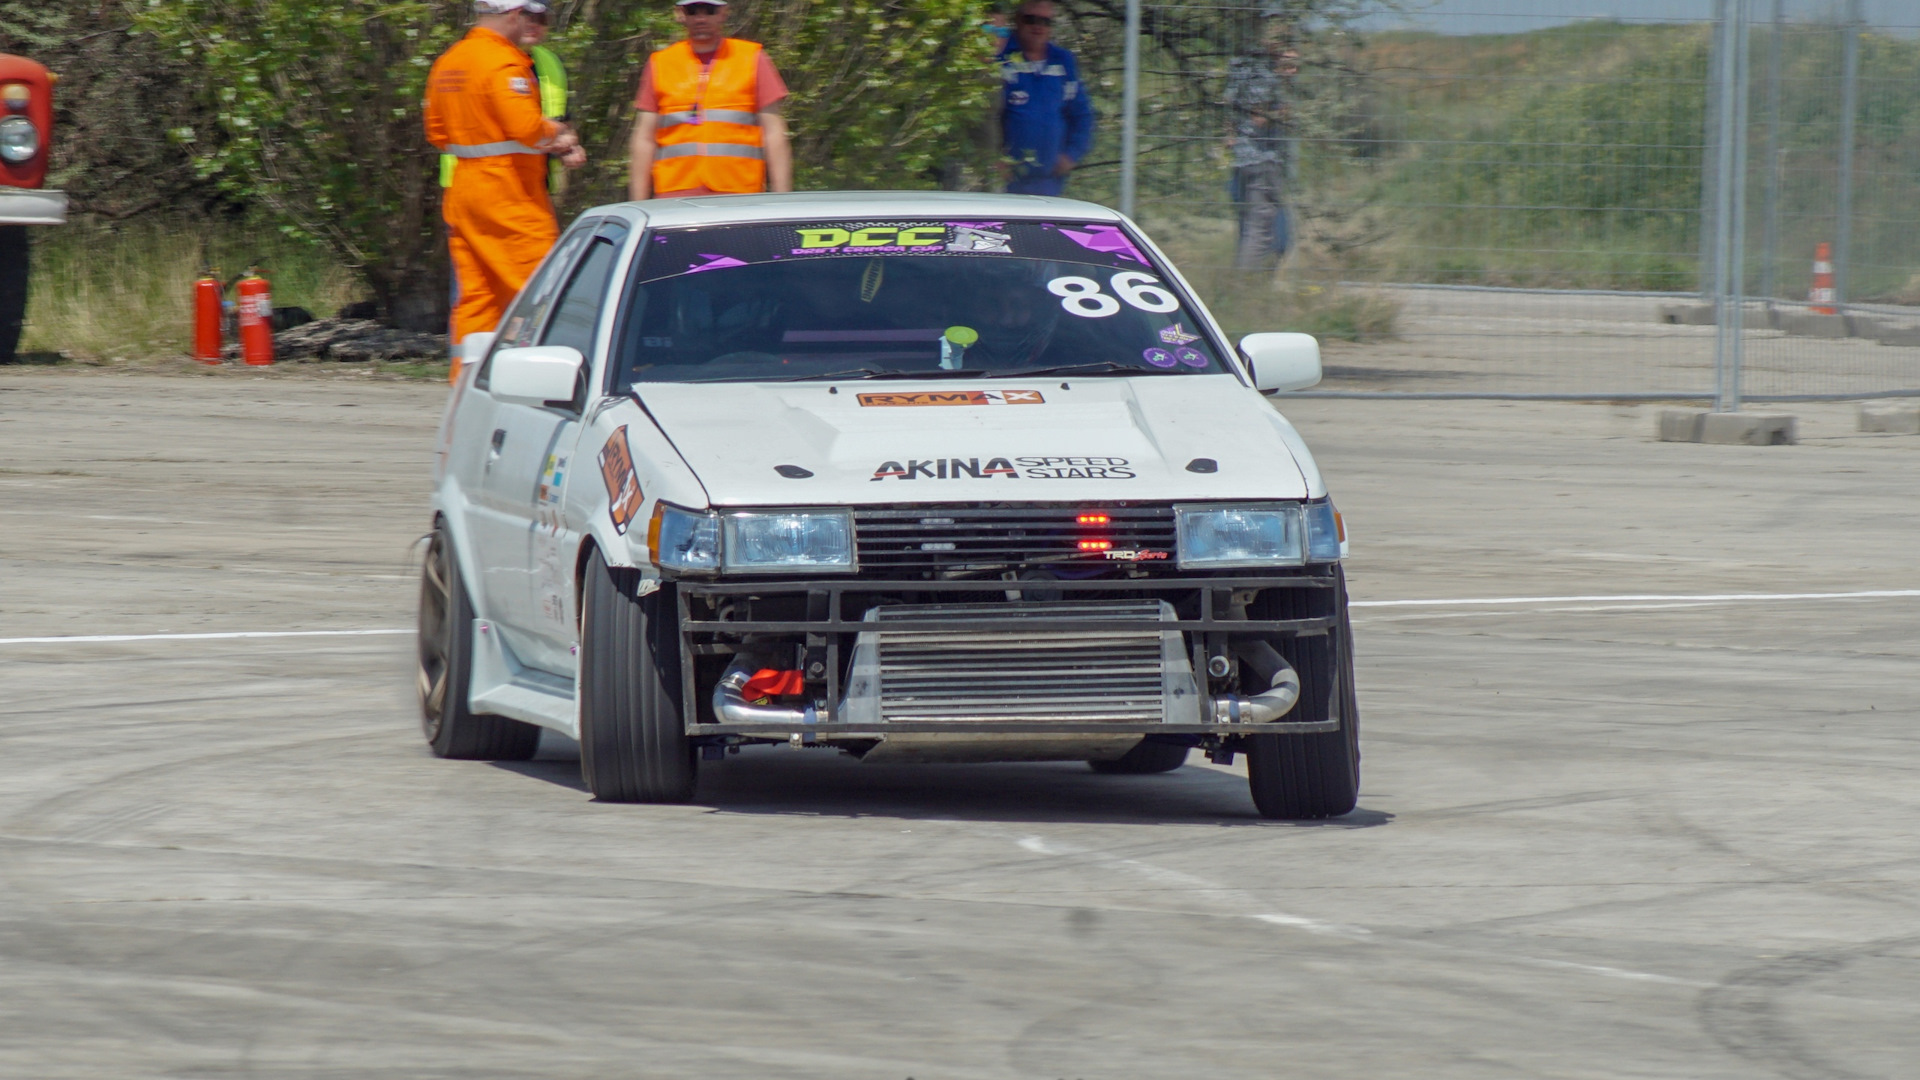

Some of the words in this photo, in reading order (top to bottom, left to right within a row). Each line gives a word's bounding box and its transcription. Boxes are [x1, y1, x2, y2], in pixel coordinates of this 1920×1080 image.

[796, 227, 945, 249] DCC
[791, 246, 839, 255] DRIFT
[1047, 272, 1179, 317] 86
[863, 391, 1038, 403] RYMAX
[1015, 457, 1129, 467] SPEED
[870, 457, 1020, 481] AKINA
[1026, 466, 1136, 479] STARS
[1103, 550, 1136, 560] TRD
